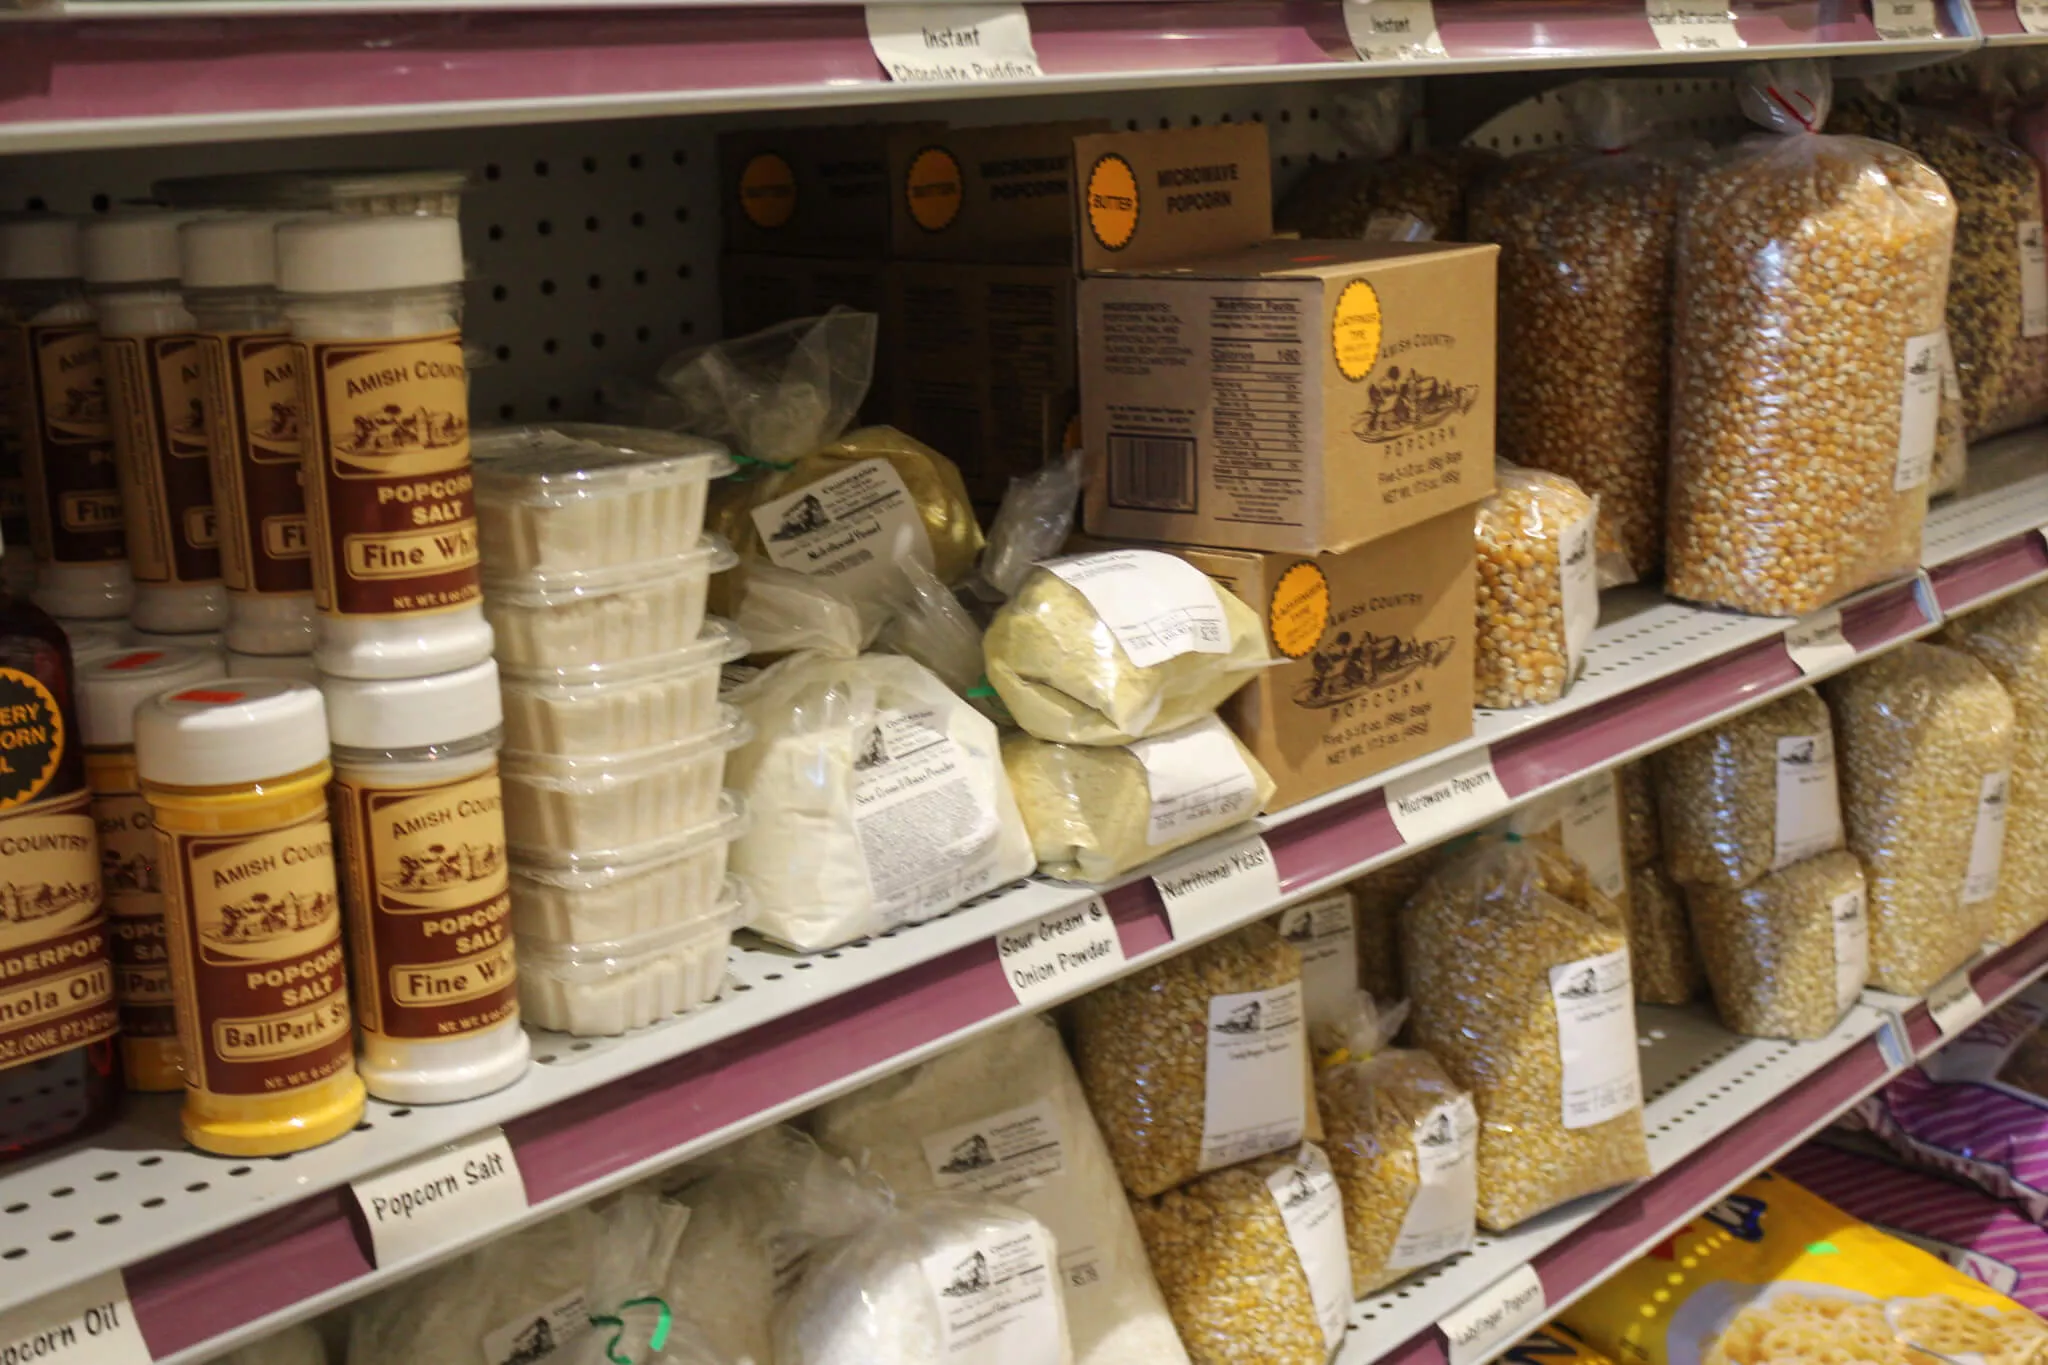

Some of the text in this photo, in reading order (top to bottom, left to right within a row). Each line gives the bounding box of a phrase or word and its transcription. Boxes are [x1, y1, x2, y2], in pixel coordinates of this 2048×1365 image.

[921, 25, 980, 49] Instant
[1158, 163, 1239, 188] MICROWAVE
[1166, 191, 1232, 215] POPCORN
[347, 367, 409, 399] AMISH
[412, 499, 463, 525] SALT
[362, 544, 424, 569] Fine
[1397, 771, 1492, 817] Microwave Popcorn
[392, 807, 451, 840] AMISH
[213, 855, 277, 890] AMISH
[1161, 847, 1270, 901] Nutritional Yeast
[455, 923, 503, 954] SALT
[1001, 902, 1103, 958] Sour Cream &
[1012, 937, 1113, 990] Onion Powder
[69, 971, 105, 1001] Oil
[282, 975, 334, 1007] SALT
[408, 973, 469, 997] Fine
[225, 1008, 326, 1049] BallPark
[370, 1152, 506, 1226] Popcorn Salt
[0, 1302, 120, 1365] pcorn Oil
